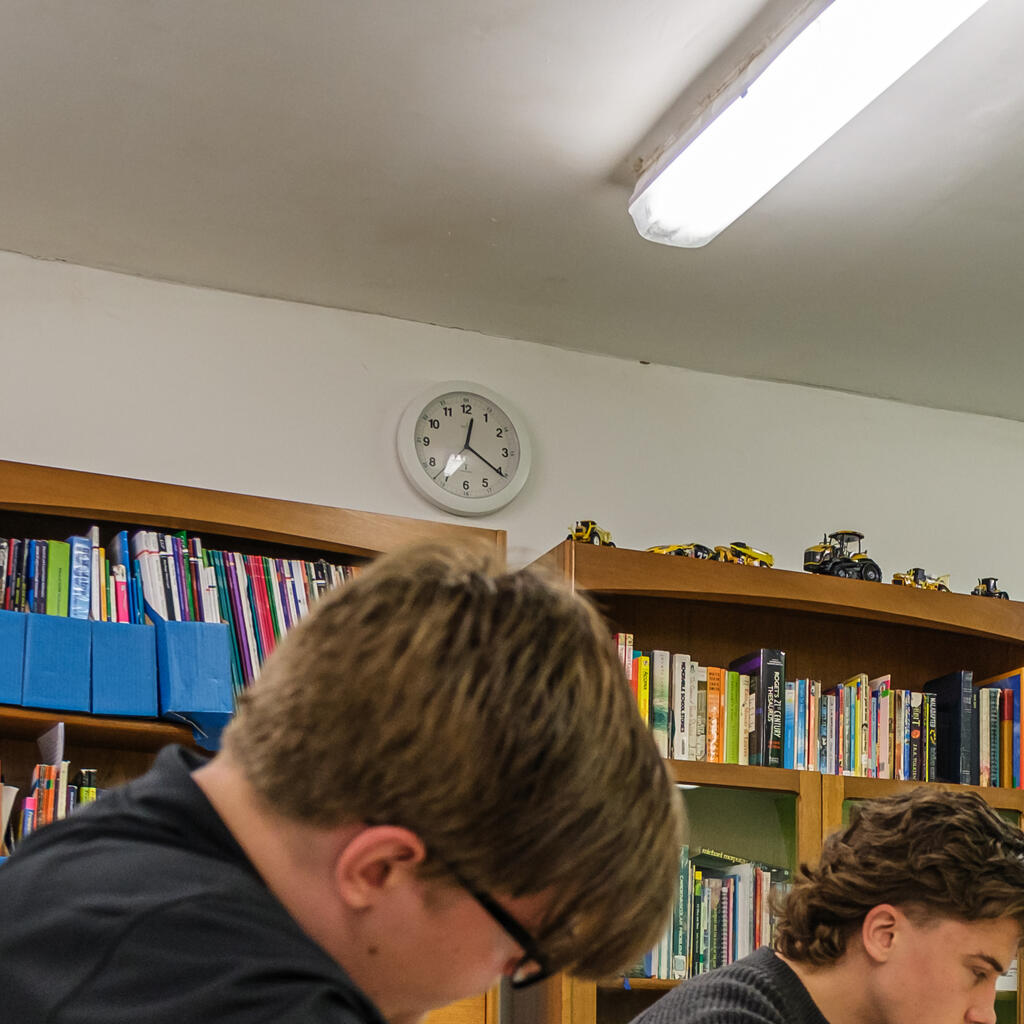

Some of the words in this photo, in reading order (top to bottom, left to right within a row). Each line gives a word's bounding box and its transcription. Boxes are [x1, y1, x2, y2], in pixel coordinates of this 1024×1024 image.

[443, 407, 452, 417] 11
[460, 404, 472, 415] 12
[483, 413, 488, 423] 1
[428, 418, 440, 429] 10
[496, 428, 503, 438] 2
[423, 437, 430, 446] 9
[501, 447, 509, 457] 3
[428, 457, 436, 467] 8
[462, 480, 470, 490] 6
[481, 478, 489, 488] 5
[773, 710, 781, 738] CENTURY
